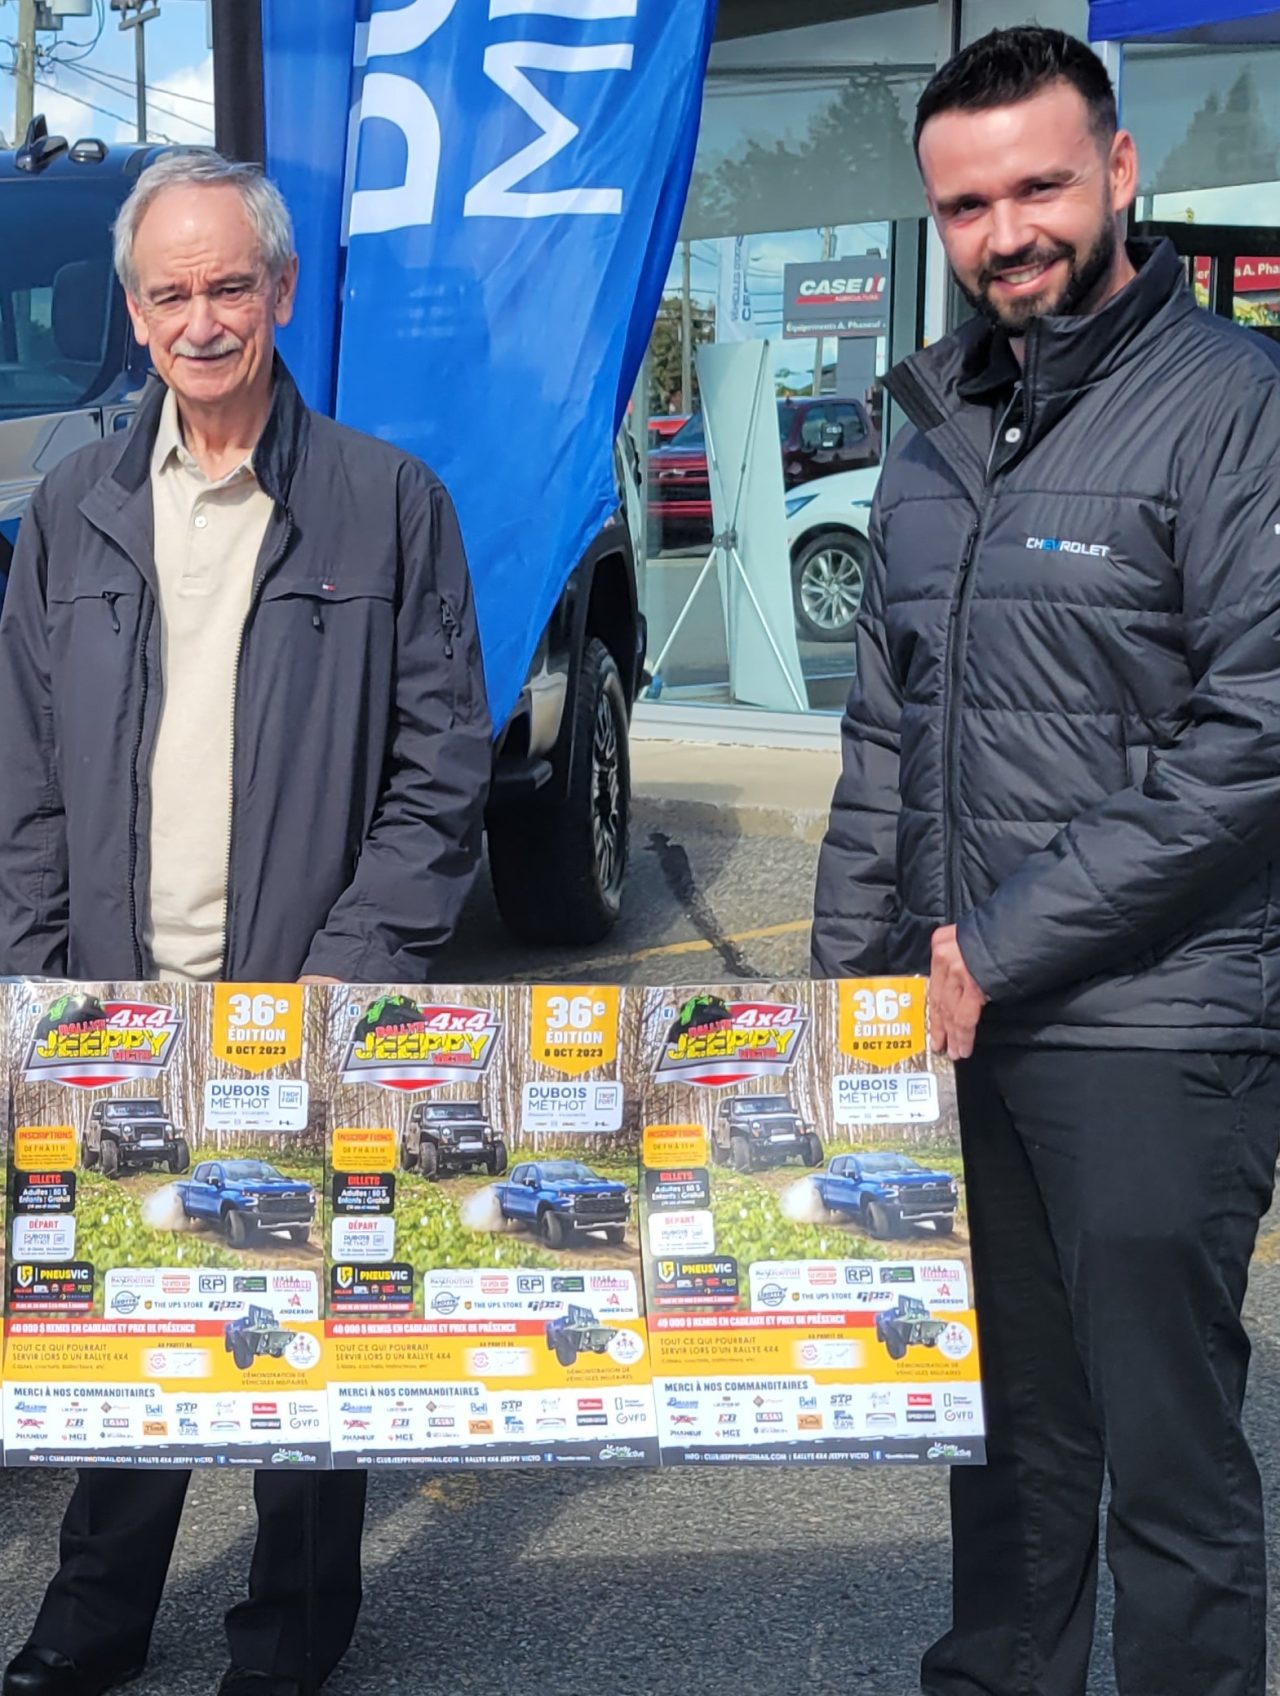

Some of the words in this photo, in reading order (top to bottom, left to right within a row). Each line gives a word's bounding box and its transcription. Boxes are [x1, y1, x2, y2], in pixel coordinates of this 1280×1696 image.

[799, 279, 863, 296] CASE
[1025, 536, 1111, 557] CHEVROLET
[228, 994, 289, 1026] 36e
[851, 987, 913, 1021] 36e
[546, 995, 605, 1028] 36e
[228, 1025, 285, 1042] ÉDITION
[853, 1019, 911, 1037] ÉDITION
[545, 1027, 602, 1044] ÉDITION
[37, 1029, 170, 1058] JEEPPY
[353, 1030, 490, 1062] JEEPPY
[665, 1025, 796, 1060] JEEPPY
[861, 1040, 883, 1049] OCT
[885, 1039, 912, 1049] 2023
[236, 1046, 256, 1054] OCT
[259, 1046, 286, 1055] 2023
[553, 1048, 573, 1057] OCT
[576, 1047, 603, 1057] 2023
[211, 1096, 270, 1109] MÉTHOT
[838, 1089, 899, 1103] MÉTHOT
[528, 1098, 586, 1111] MÉTHOT
[29, 1218, 59, 1229] DÉPART
[348, 1219, 378, 1230] DÉPART
[847, 1268, 871, 1281] RP
[201, 1278, 224, 1290] RP
[519, 1278, 542, 1290] RP
[14, 1387, 43, 1397] MERCI
[45, 1385, 51, 1396] À
[53, 1388, 72, 1397] NOS
[74, 1388, 155, 1398] COMMANDITAIRES
[338, 1387, 367, 1397] MERCI
[370, 1385, 375, 1396] À
[377, 1387, 396, 1397] NOS
[398, 1386, 479, 1397] COMMANDITAIRES
[664, 1382, 693, 1392] MERCI
[695, 1380, 701, 1391] À
[703, 1381, 723, 1391] NOS
[724, 1380, 808, 1391] COMMANDITAIRES
[145, 1404, 162, 1414] Bell
